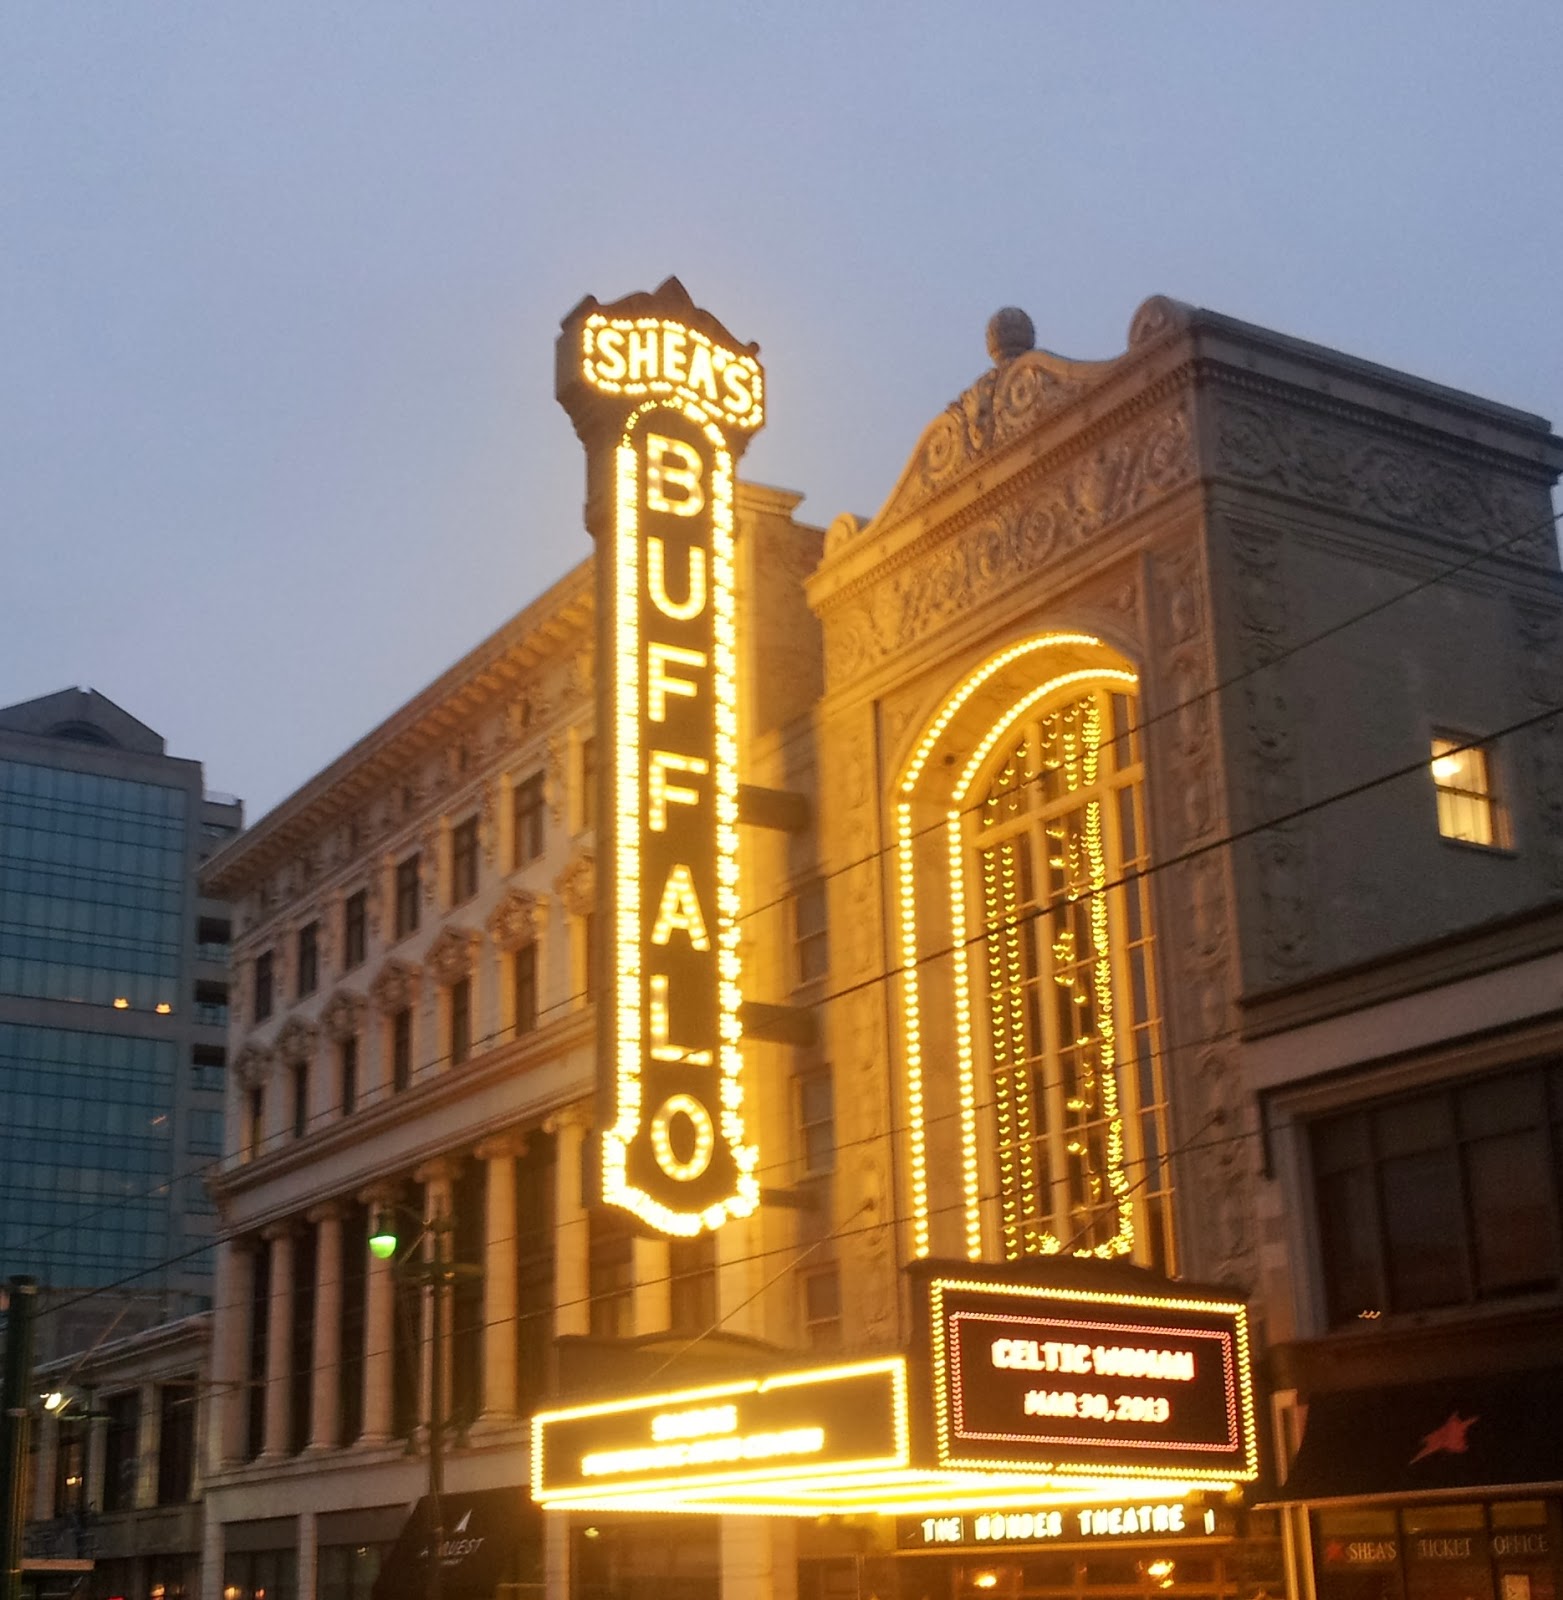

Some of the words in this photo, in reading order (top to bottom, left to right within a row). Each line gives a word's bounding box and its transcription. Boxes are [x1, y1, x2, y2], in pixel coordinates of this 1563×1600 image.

[596, 327, 753, 414] SHEA'S
[646, 432, 714, 1182] BUFFALO
[991, 1338, 1092, 1374] CELTIC
[1092, 1345, 1195, 1381] WOMAN
[922, 1517, 961, 1542] THE
[975, 1511, 1062, 1541] WONDER
[1077, 1504, 1186, 1536] THEATRE
[1349, 1541, 1397, 1560] SHEA'S
[1418, 1537, 1472, 1558] TICKET
[1493, 1533, 1549, 1555] OFFICE
